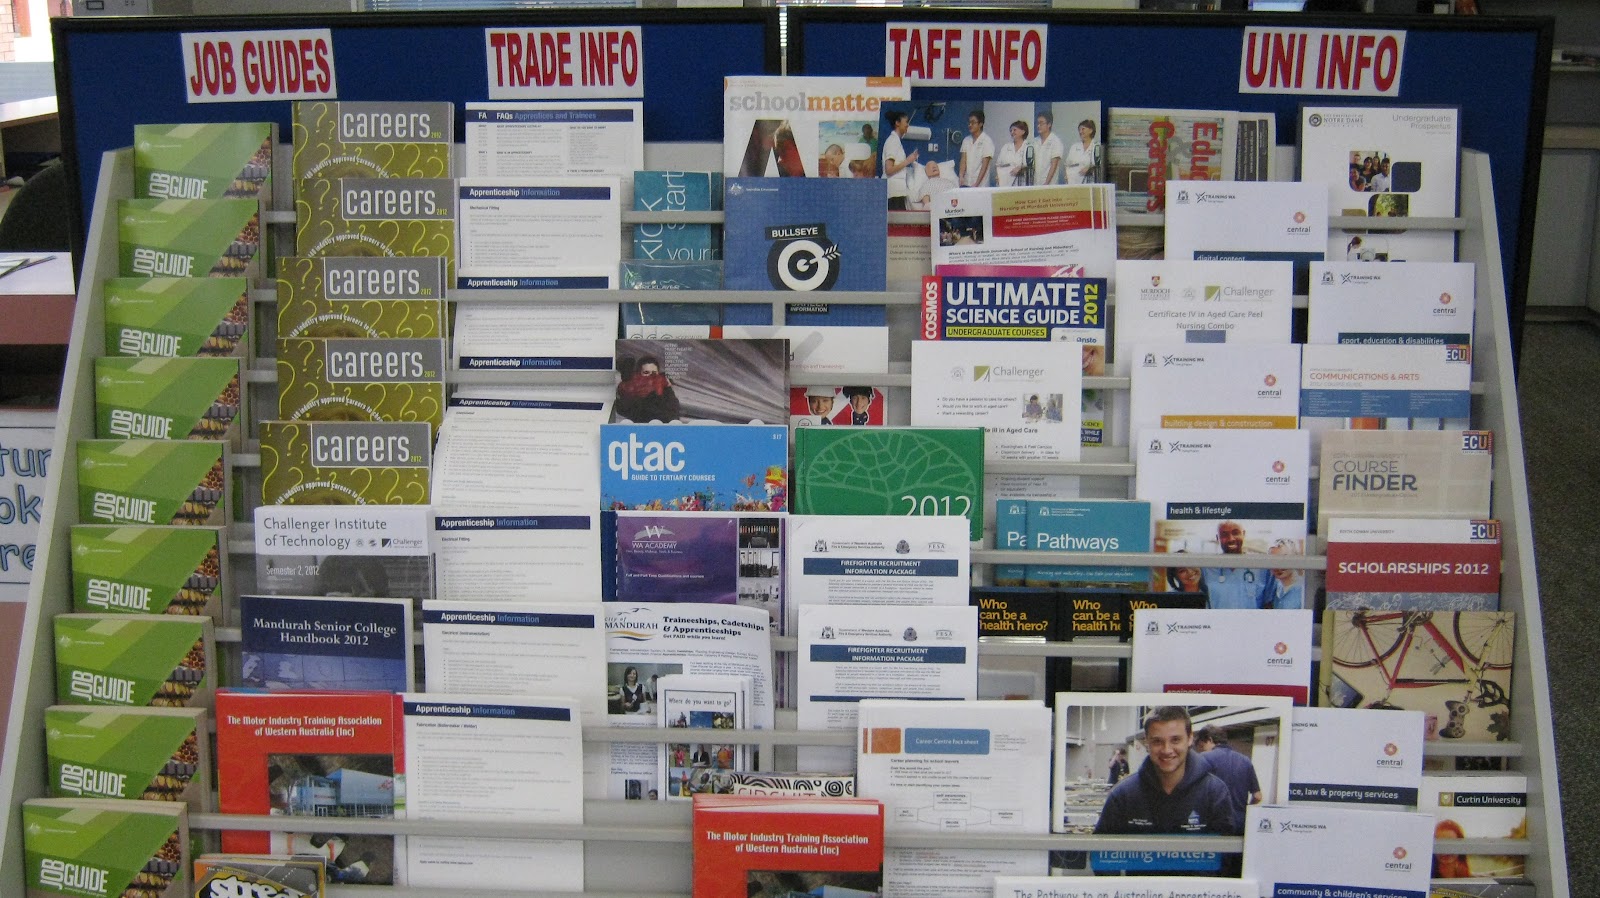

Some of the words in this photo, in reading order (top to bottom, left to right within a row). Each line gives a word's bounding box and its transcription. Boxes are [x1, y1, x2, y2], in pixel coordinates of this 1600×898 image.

[490, 33, 573, 87] TRADE
[580, 31, 637, 87] INFO
[890, 29, 961, 79] TAFE
[972, 29, 1042, 81] INFO
[191, 42, 236, 96] JOB
[243, 39, 331, 95] GUIDES
[1246, 32, 1307, 88] UNI
[1316, 35, 1398, 92] INFO
[497, 112, 513, 120] FAQs
[515, 113, 554, 121] Apprentices
[1393, 115, 1450, 123] Undergraduate
[343, 112, 431, 138] careers
[149, 172, 170, 199] JOB
[169, 177, 208, 199] GUIDE
[470, 188, 519, 197] Apprenticeship
[522, 188, 560, 196] Information
[346, 189, 436, 215] careers
[772, 227, 818, 238] BULLSEYE
[329, 269, 420, 295] careers
[946, 283, 1080, 306] ULTIMATE
[1224, 287, 1273, 298] Challenger
[926, 282, 937, 339] COSMOS
[1084, 284, 1098, 324] 2012
[946, 309, 1019, 324] SCIENCE
[1024, 310, 1080, 324] GUIDE
[1208, 311, 1226, 319] Aged
[948, 328, 1010, 336] UNDERGRADUATE
[1177, 322, 1205, 330] Nursing
[331, 352, 423, 378] careers
[993, 367, 1044, 378] Challenger
[1165, 420, 1192, 429] building
[1194, 420, 1218, 429] design
[316, 435, 409, 462] careers
[1462, 436, 1487, 449] ECU
[608, 433, 685, 480] qtac
[1334, 461, 1398, 472] COURSE
[1333, 475, 1417, 490] FINDER
[93, 492, 115, 522] JOB
[115, 497, 156, 523] GUIDE
[901, 496, 971, 516] 2012
[1202, 507, 1232, 515] lifestyle
[264, 518, 329, 532] Challenger
[335, 518, 386, 529] Institute
[441, 518, 495, 527] Apprenticeship
[1471, 525, 1495, 538] ECU
[265, 535, 277, 546] of
[280, 536, 350, 550] Technology
[1037, 533, 1118, 551] Pathways
[266, 565, 296, 575] Semester
[305, 566, 319, 575] 2012
[1338, 562, 1450, 574] SCHOLARSHIPS
[1455, 563, 1489, 574] 2012
[980, 599, 1007, 609] Who
[980, 612, 1000, 620] can
[1003, 611, 1017, 620] be
[254, 618, 311, 630] Mandurah
[315, 621, 350, 632] Senior
[355, 623, 397, 638] College
[663, 616, 719, 626] Traineeships,
[721, 619, 764, 631] Cadetships
[979, 621, 1014, 630] health
[1017, 621, 1048, 631] hero?
[673, 626, 741, 636] Apprenticeships
[280, 633, 340, 644] Handbook
[344, 635, 369, 646] 2012
[71, 670, 93, 701] JOB
[93, 675, 135, 703] GUIDE
[416, 704, 470, 714] Apprenticeship
[472, 707, 515, 716] Information
[227, 715, 240, 724] The
[243, 716, 267, 725] Motor
[269, 716, 301, 727] Industry
[304, 716, 336, 726] Training
[338, 716, 382, 725] Association
[255, 727, 263, 736] of
[265, 727, 297, 736] Western
[299, 728, 334, 736] Australia
[337, 728, 354, 737] (Inc)
[1320, 788, 1327, 796] &
[1329, 789, 1362, 799] property
[1482, 796, 1520, 804] University
[40, 859, 64, 889] JOB
[64, 863, 109, 893] GUIDE
[1278, 889, 1322, 898] community
[1325, 889, 1331, 897] &
[1333, 889, 1371, 898] children's
